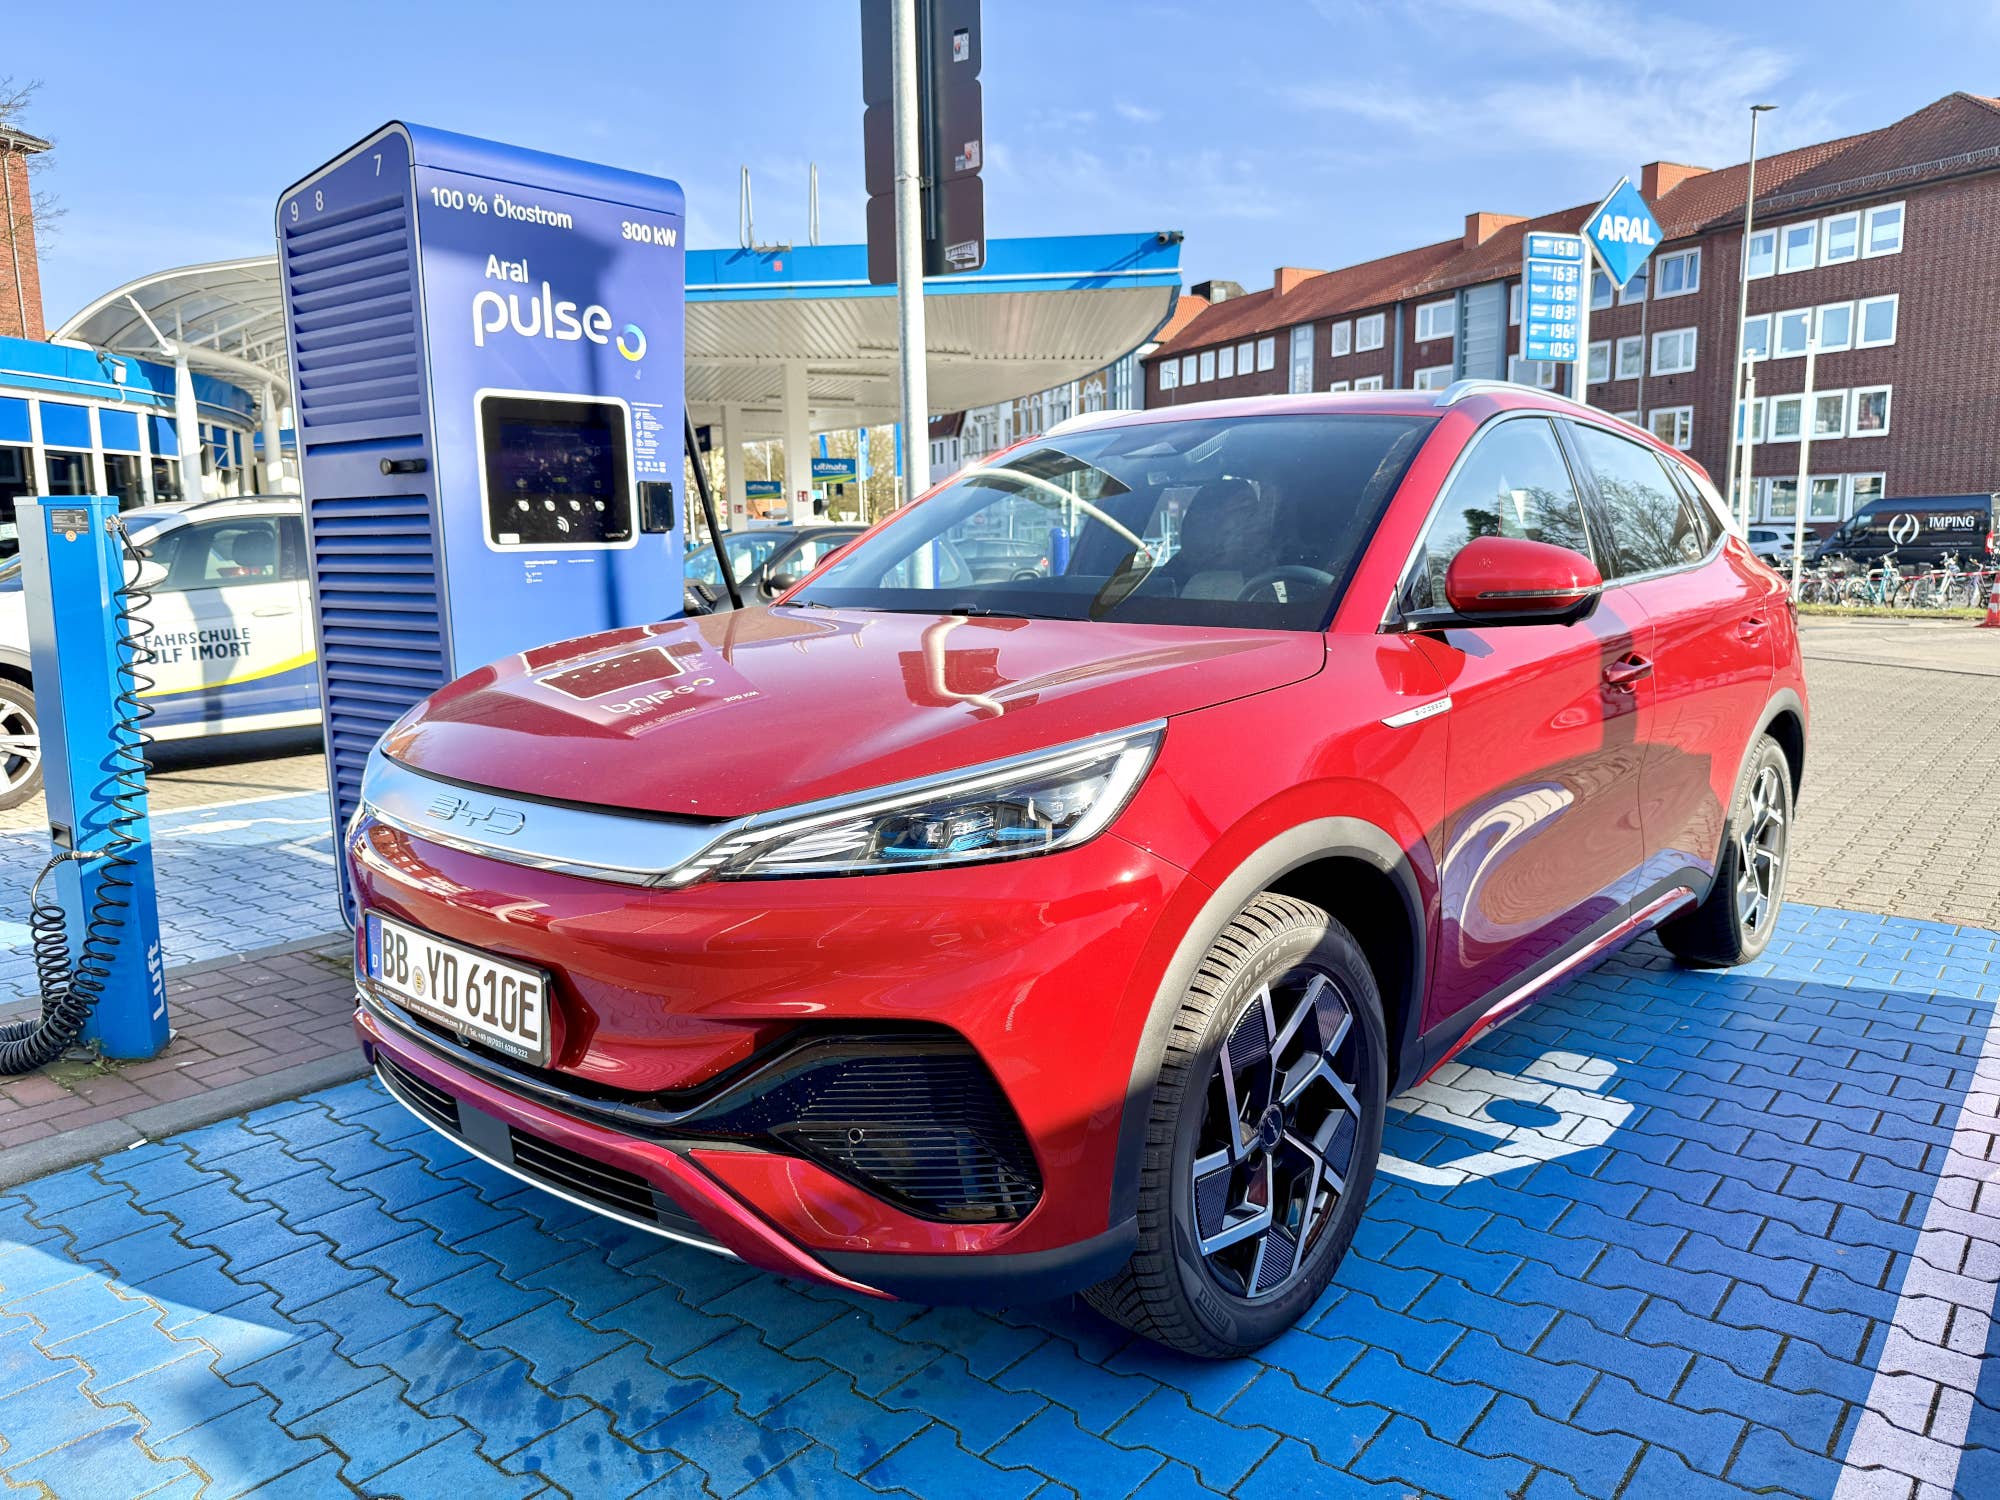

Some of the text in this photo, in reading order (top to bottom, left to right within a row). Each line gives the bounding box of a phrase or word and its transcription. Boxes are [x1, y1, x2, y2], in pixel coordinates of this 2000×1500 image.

[373, 153, 382, 177] 7
[290, 201, 299, 223] 9
[315, 190, 324, 212] 8
[430, 187, 573, 230] 100 % Ökostrom
[621, 221, 677, 248] 300 kW
[1598, 214, 1655, 246] ARAL
[485, 254, 529, 284] Aral
[472, 280, 613, 348] pulse
[813, 463, 848, 471] ultimate
[1929, 515, 1975, 528] IMPING
[143, 627, 251, 648] FAHRSCHULE
[191, 642, 251, 661] IMORT
[372, 954, 378, 968] D
[147, 939, 165, 1021] Luft
[382, 927, 537, 1042] BB YD 610E
